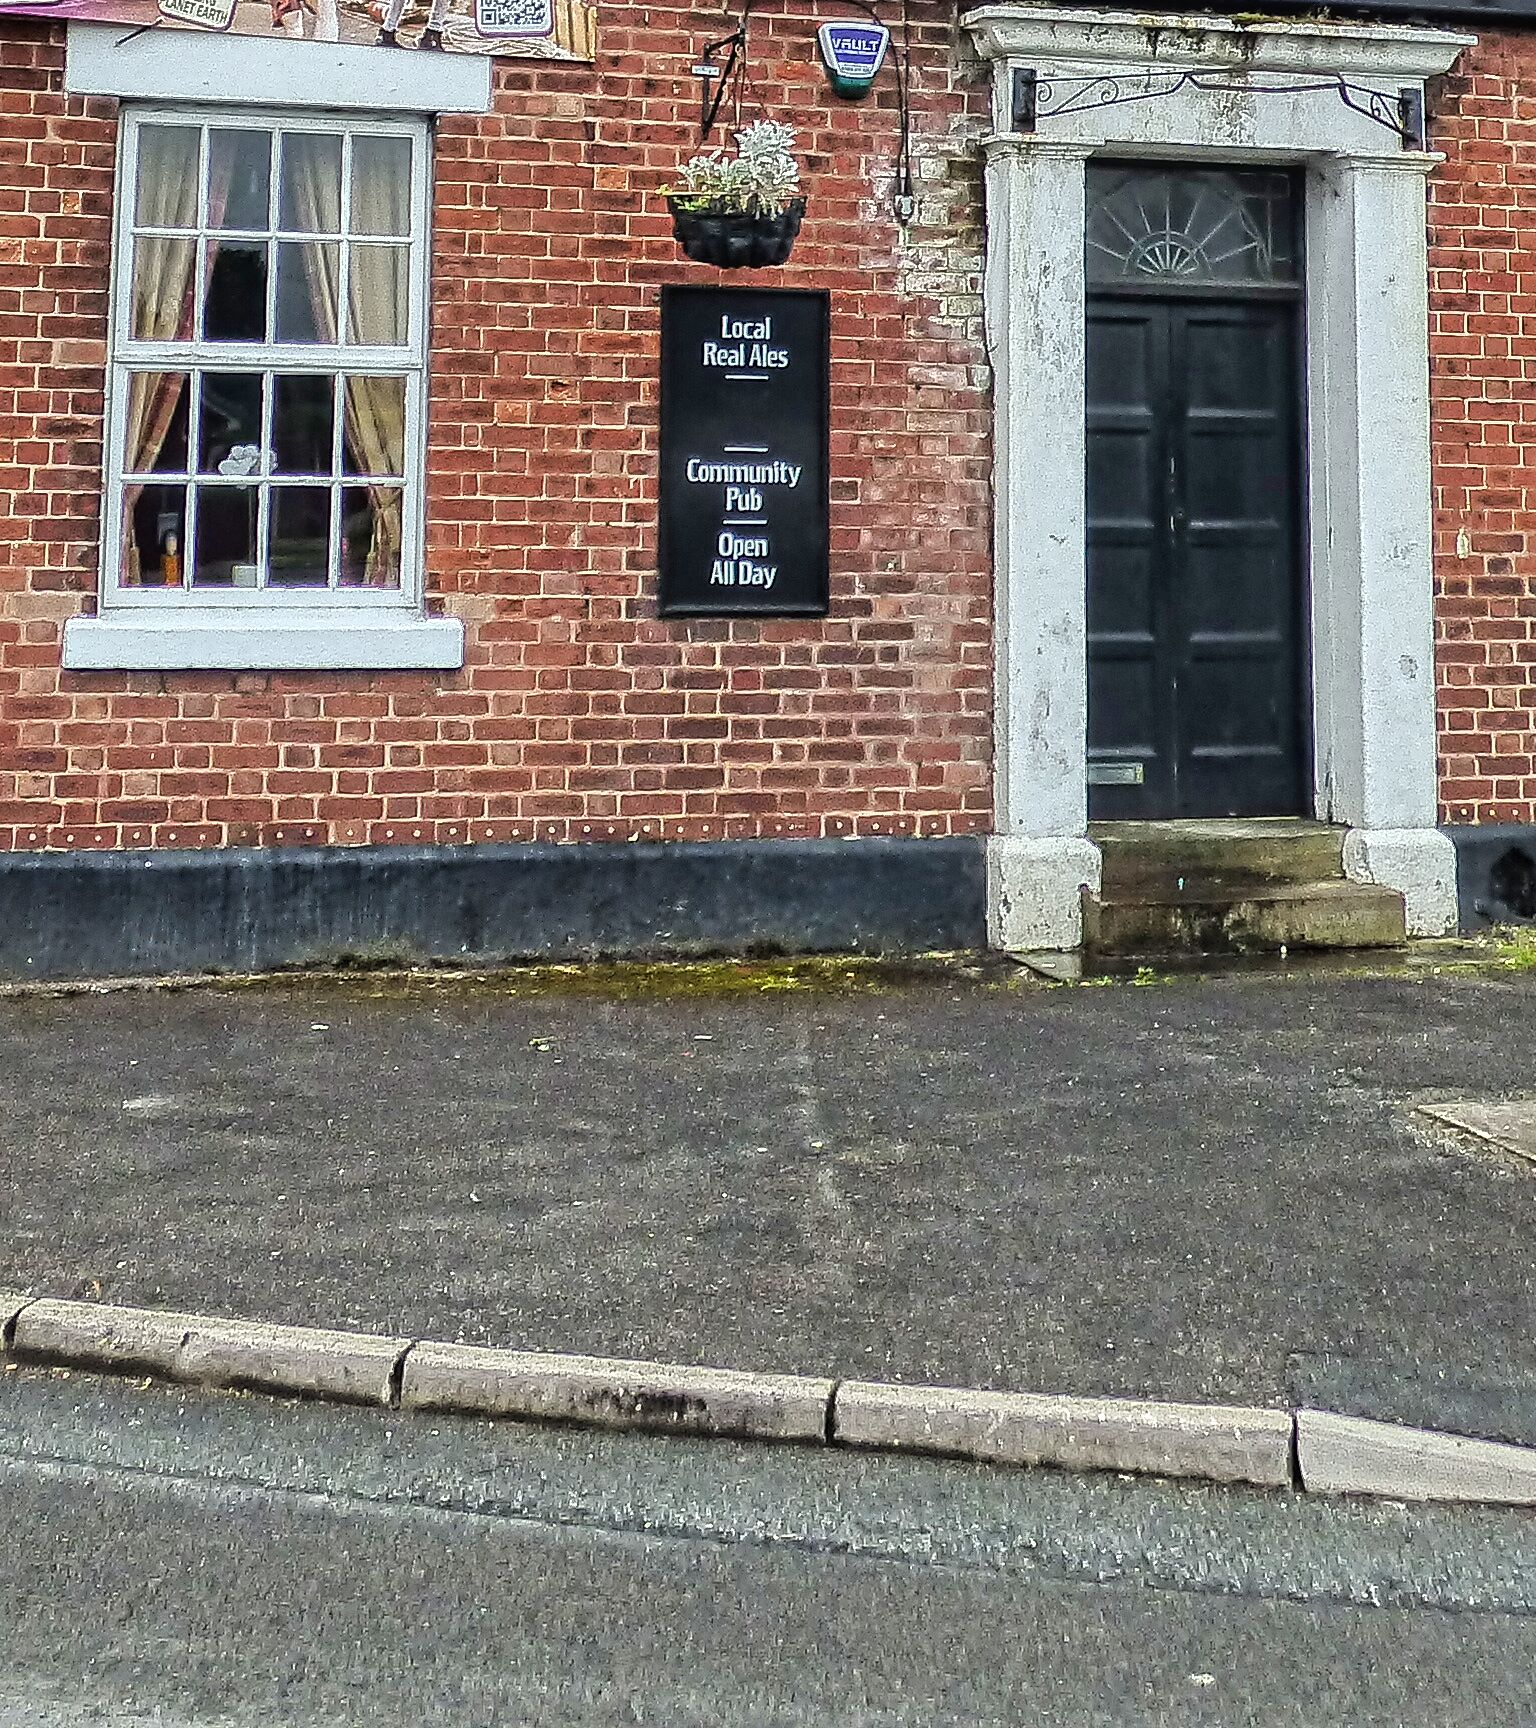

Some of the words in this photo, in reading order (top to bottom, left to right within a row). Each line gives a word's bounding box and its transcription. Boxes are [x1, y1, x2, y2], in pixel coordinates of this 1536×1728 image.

[197, 4, 228, 24] EARTH
[832, 37, 879, 51] VAULT
[721, 315, 771, 340] Local
[703, 341, 745, 367] Real
[749, 343, 789, 369] Ales
[686, 459, 802, 489] Community
[725, 486, 763, 513] Pub
[718, 532, 768, 559] Open
[710, 560, 735, 586] All
[738, 561, 777, 589] Day
